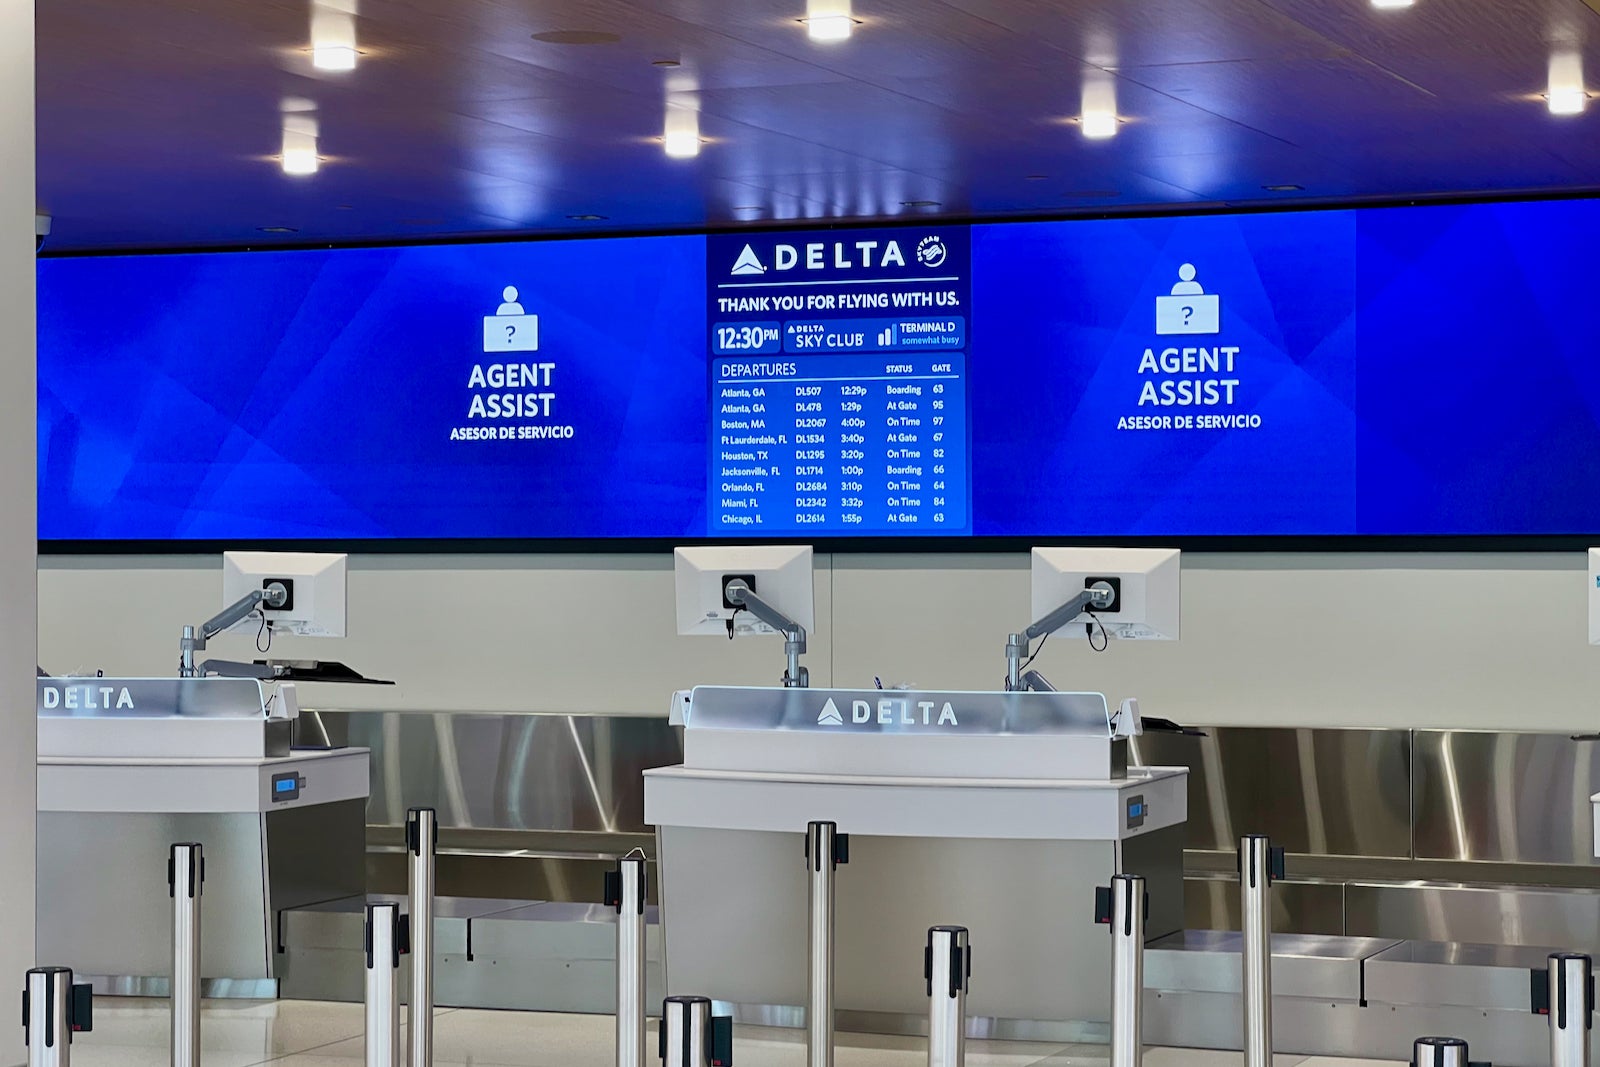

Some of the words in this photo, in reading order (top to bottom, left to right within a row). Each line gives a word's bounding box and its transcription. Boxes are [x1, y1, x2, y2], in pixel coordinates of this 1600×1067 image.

[775, 241, 905, 271] DELTA
[718, 298, 770, 312] THANK
[772, 296, 804, 310] YOU
[808, 295, 835, 309] FOR
[839, 294, 888, 309] FLYING
[891, 292, 932, 307] WITH
[936, 292, 959, 306] US.
[900, 323, 946, 333] TERMINAL
[948, 323, 956, 332] D
[796, 335, 822, 348] SKY
[826, 334, 864, 347] CLUB
[902, 336, 940, 344] somewhat
[942, 335, 959, 345] busy
[1138, 347, 1240, 373] AGENT
[722, 363, 796, 377] DEPARTURES
[886, 365, 912, 373] STATUS
[932, 364, 951, 372] GATE
[468, 363, 555, 388] AGENT
[721, 389, 751, 398] Atlanta,
[753, 388, 765, 397] GA
[796, 387, 821, 396] DL507
[841, 386, 867, 396] 12:29p
[887, 385, 921, 396] Boarding
[933, 385, 943, 393] 63
[1138, 380, 1240, 406] ASSIST
[468, 393, 555, 418] ASSIST
[721, 405, 751, 413] Atlanta,
[753, 404, 765, 413] GA
[796, 403, 822, 412] DL478
[841, 402, 861, 412] 1:29p
[887, 402, 896, 410] At
[898, 402, 917, 410] Gate
[933, 401, 943, 409] 95
[722, 420, 749, 429] Boston,
[751, 420, 765, 428] MA
[796, 419, 826, 428] DL2067
[841, 418, 865, 428] 4:00p
[887, 418, 899, 426] On
[900, 417, 920, 426] Time
[933, 417, 943, 425] 97
[1117, 416, 1171, 429] ASESOR
[1175, 416, 1192, 429] DE
[1196, 414, 1261, 428] SERVICIO
[450, 427, 497, 440] ASESOR
[500, 427, 515, 439] DE
[518, 426, 574, 439] SERVICIO
[722, 436, 729, 444] Ft
[779, 435, 787, 444] FL
[796, 435, 824, 443] DL1534
[841, 434, 864, 444] 3:40p
[887, 434, 896, 442] At
[898, 433, 917, 442] Gate
[933, 433, 943, 441] 67
[722, 452, 755, 461] Houston,
[757, 451, 768, 459] TX
[796, 451, 825, 459] DL1295
[841, 450, 864, 460] 3:20p
[887, 450, 899, 458] On
[900, 449, 920, 458] Time
[933, 449, 944, 457] 82
[722, 467, 768, 476] Jacksonville,
[771, 467, 780, 475] FL
[796, 466, 823, 475] DL1714
[841, 466, 863, 475] 1:00p
[887, 466, 922, 476] Boarding
[933, 465, 944, 474] 66
[722, 483, 754, 492] Orlando,
[756, 483, 764, 491] FL
[796, 482, 827, 491] DL2684
[841, 482, 862, 492] 3:10p
[887, 482, 899, 490] On
[901, 481, 920, 490] Time
[934, 481, 944, 490] 64
[722, 499, 747, 508] Miami,
[750, 499, 758, 507] FL
[796, 498, 826, 507] DL2342
[841, 498, 863, 508] 3:32p
[887, 498, 899, 506] On
[901, 497, 920, 506] Time
[934, 497, 944, 506] 84
[722, 515, 754, 525] Chicago,
[756, 515, 762, 523] IL
[796, 514, 825, 523] DL2614
[842, 514, 862, 524] 1:55p
[887, 514, 897, 522] At
[899, 513, 918, 522] Gate
[934, 513, 944, 522] 63
[42, 686, 135, 710] DELTA
[852, 700, 959, 726] DELTA
